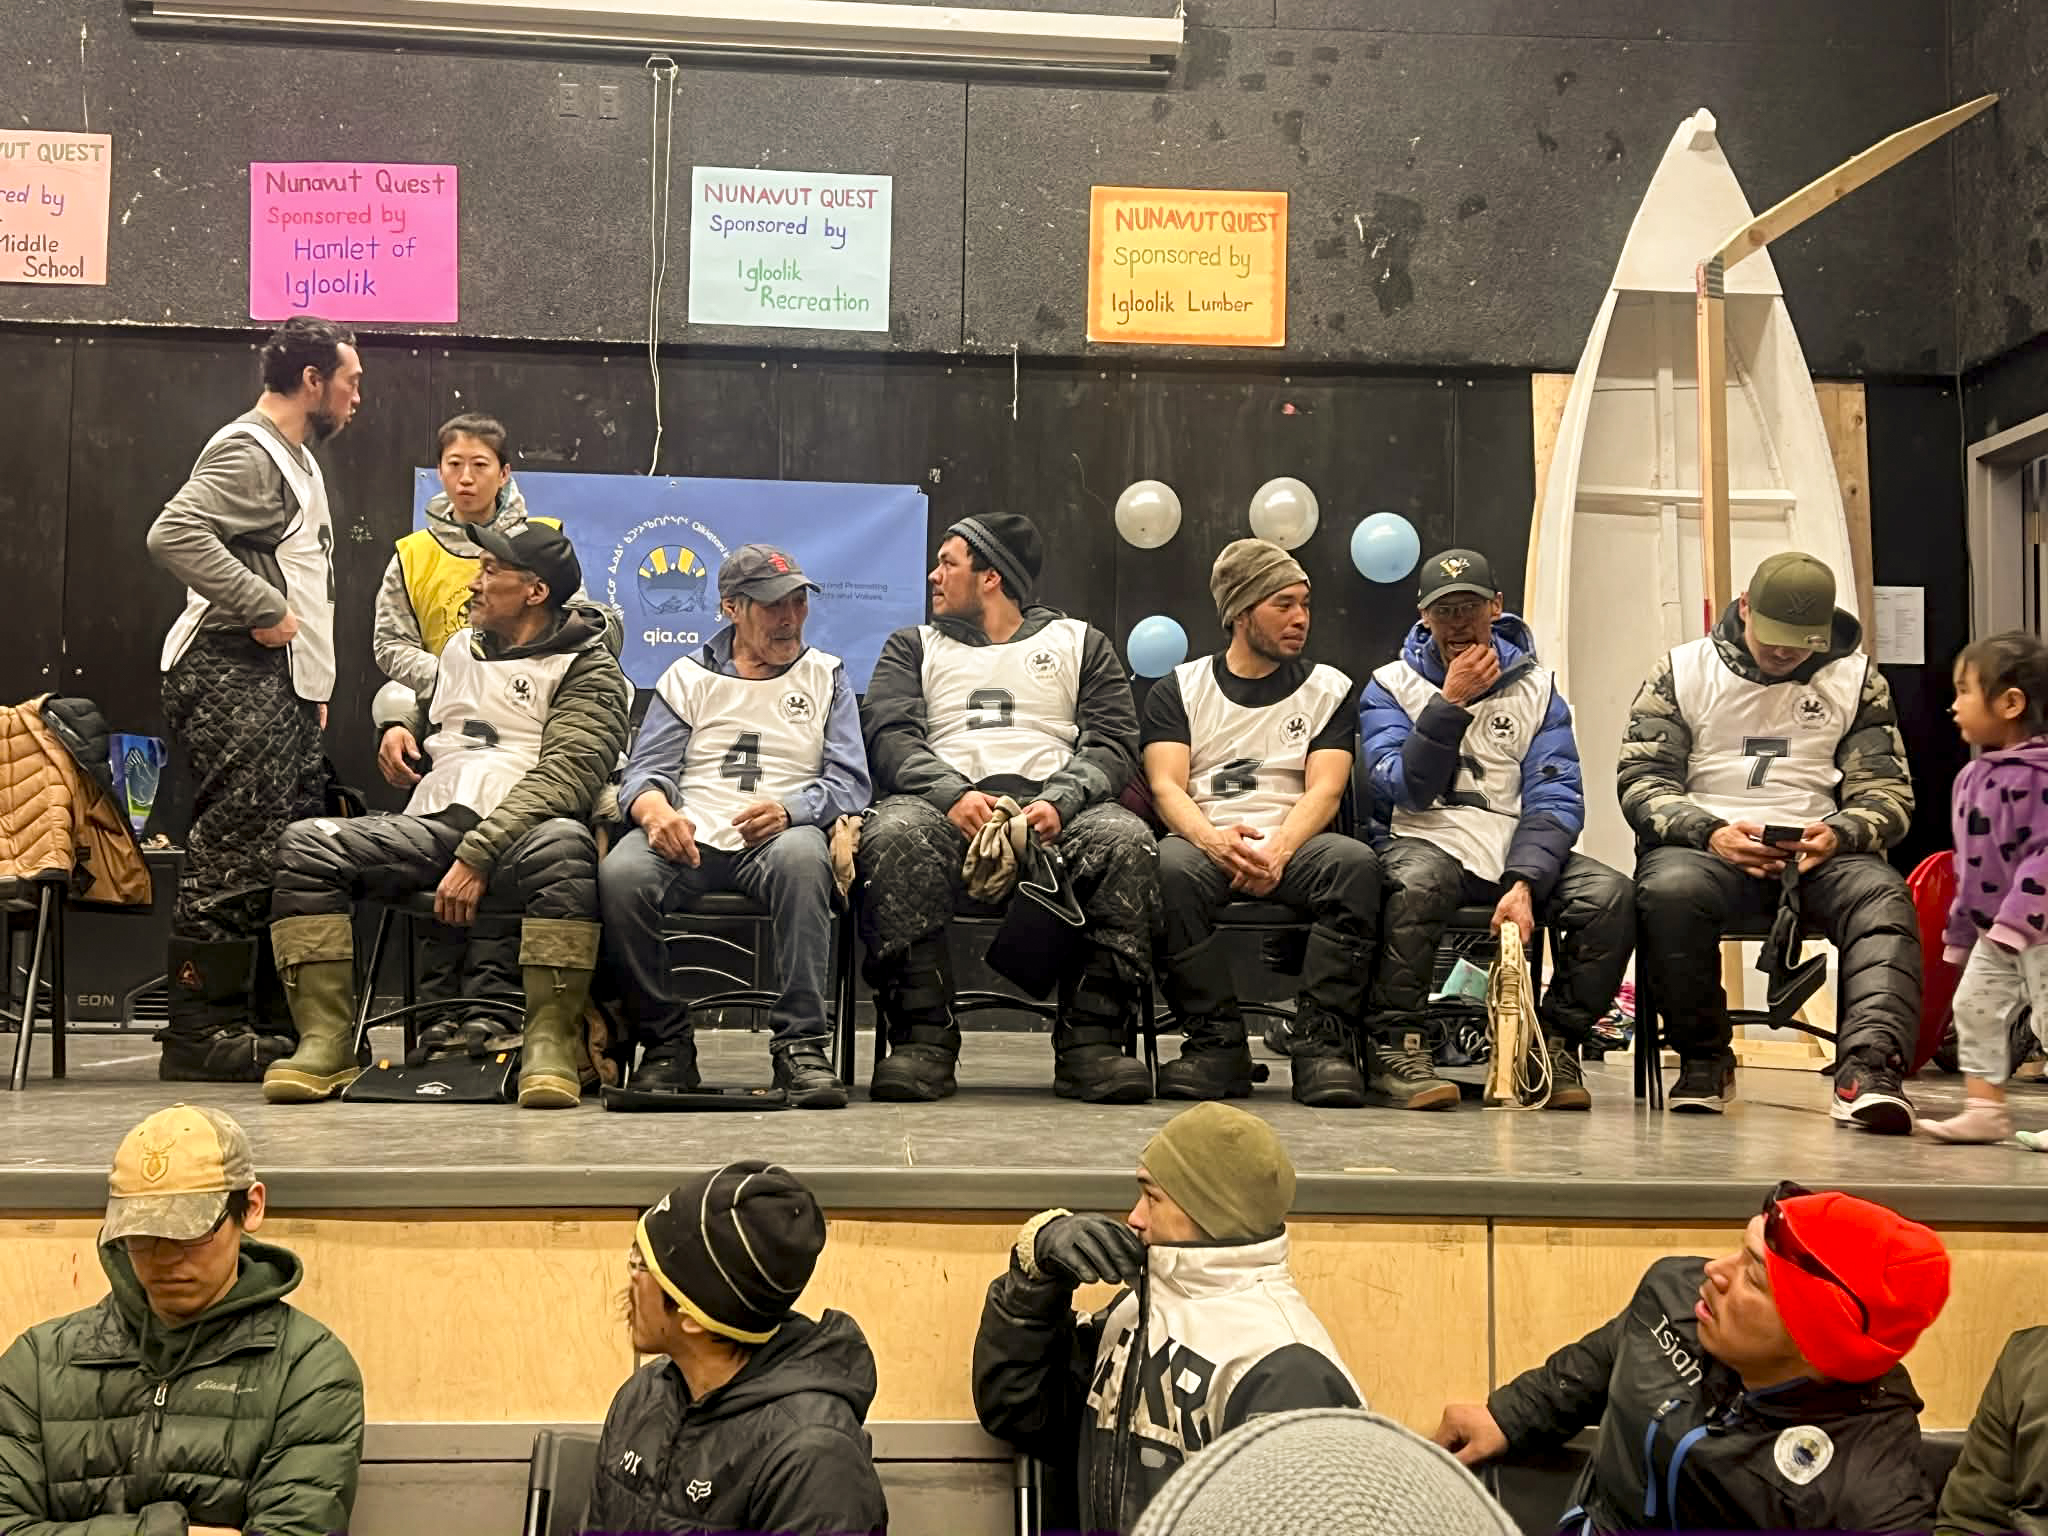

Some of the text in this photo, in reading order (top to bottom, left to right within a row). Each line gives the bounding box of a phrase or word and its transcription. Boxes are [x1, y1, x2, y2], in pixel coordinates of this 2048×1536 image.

[37, 143, 105, 164] QUEST
[265, 168, 446, 195] Nunavut Quest
[704, 183, 879, 209] NUNAVUT QUEST
[41, 184, 65, 216] by
[266, 203, 407, 233] Sponsored by
[709, 214, 847, 250] Sponsored by
[1115, 206, 1281, 233] NUNAVUT QUEST
[294, 235, 417, 261] Hamlet of
[1113, 245, 1251, 279] Sponsored by
[22, 255, 84, 278] School
[737, 258, 802, 292] Igloolik
[285, 268, 377, 308] Igloolik
[760, 284, 870, 313] Recreation
[1112, 288, 1254, 326] Igloolik Lumber
[643, 627, 699, 647] qia.ca
[720, 731, 762, 794] 4
[1742, 735, 1792, 790] 7
[78, 995, 114, 1007] EON
[1649, 1313, 1704, 1388] Isiah
